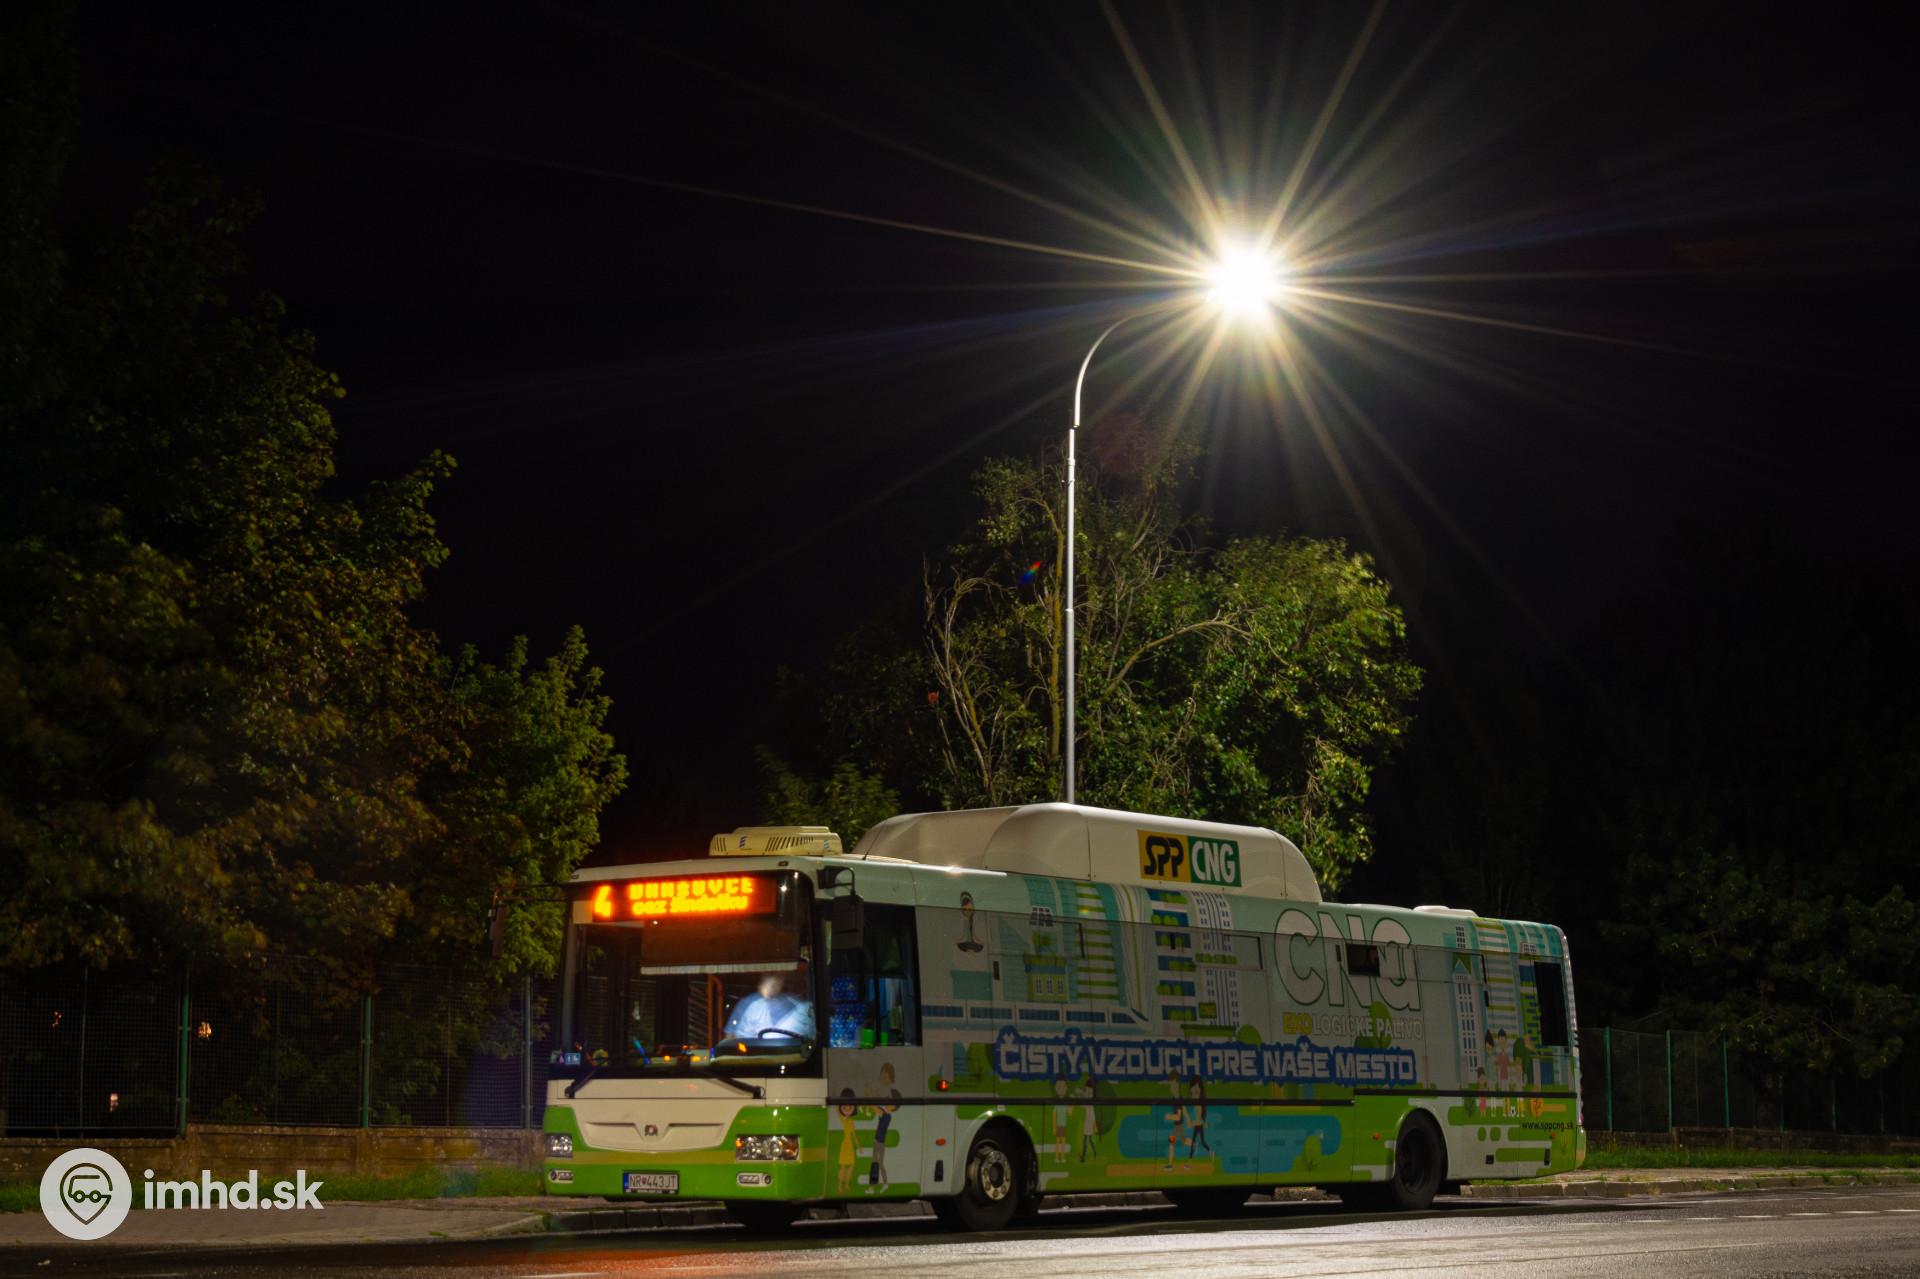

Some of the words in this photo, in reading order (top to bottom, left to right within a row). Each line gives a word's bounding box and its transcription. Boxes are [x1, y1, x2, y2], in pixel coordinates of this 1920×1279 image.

[1143, 835, 1184, 878] SPP
[1191, 840, 1236, 883] CNG
[1000, 1032, 1082, 1074] ČISTÝ
[1088, 1046, 1201, 1076] VZDUCH
[1206, 1049, 1258, 1077] PRE
[1263, 1041, 1330, 1078] NAŠE
[1335, 1052, 1414, 1081] MESTO
[1522, 1121, 1574, 1131] www.sppcng.sk
